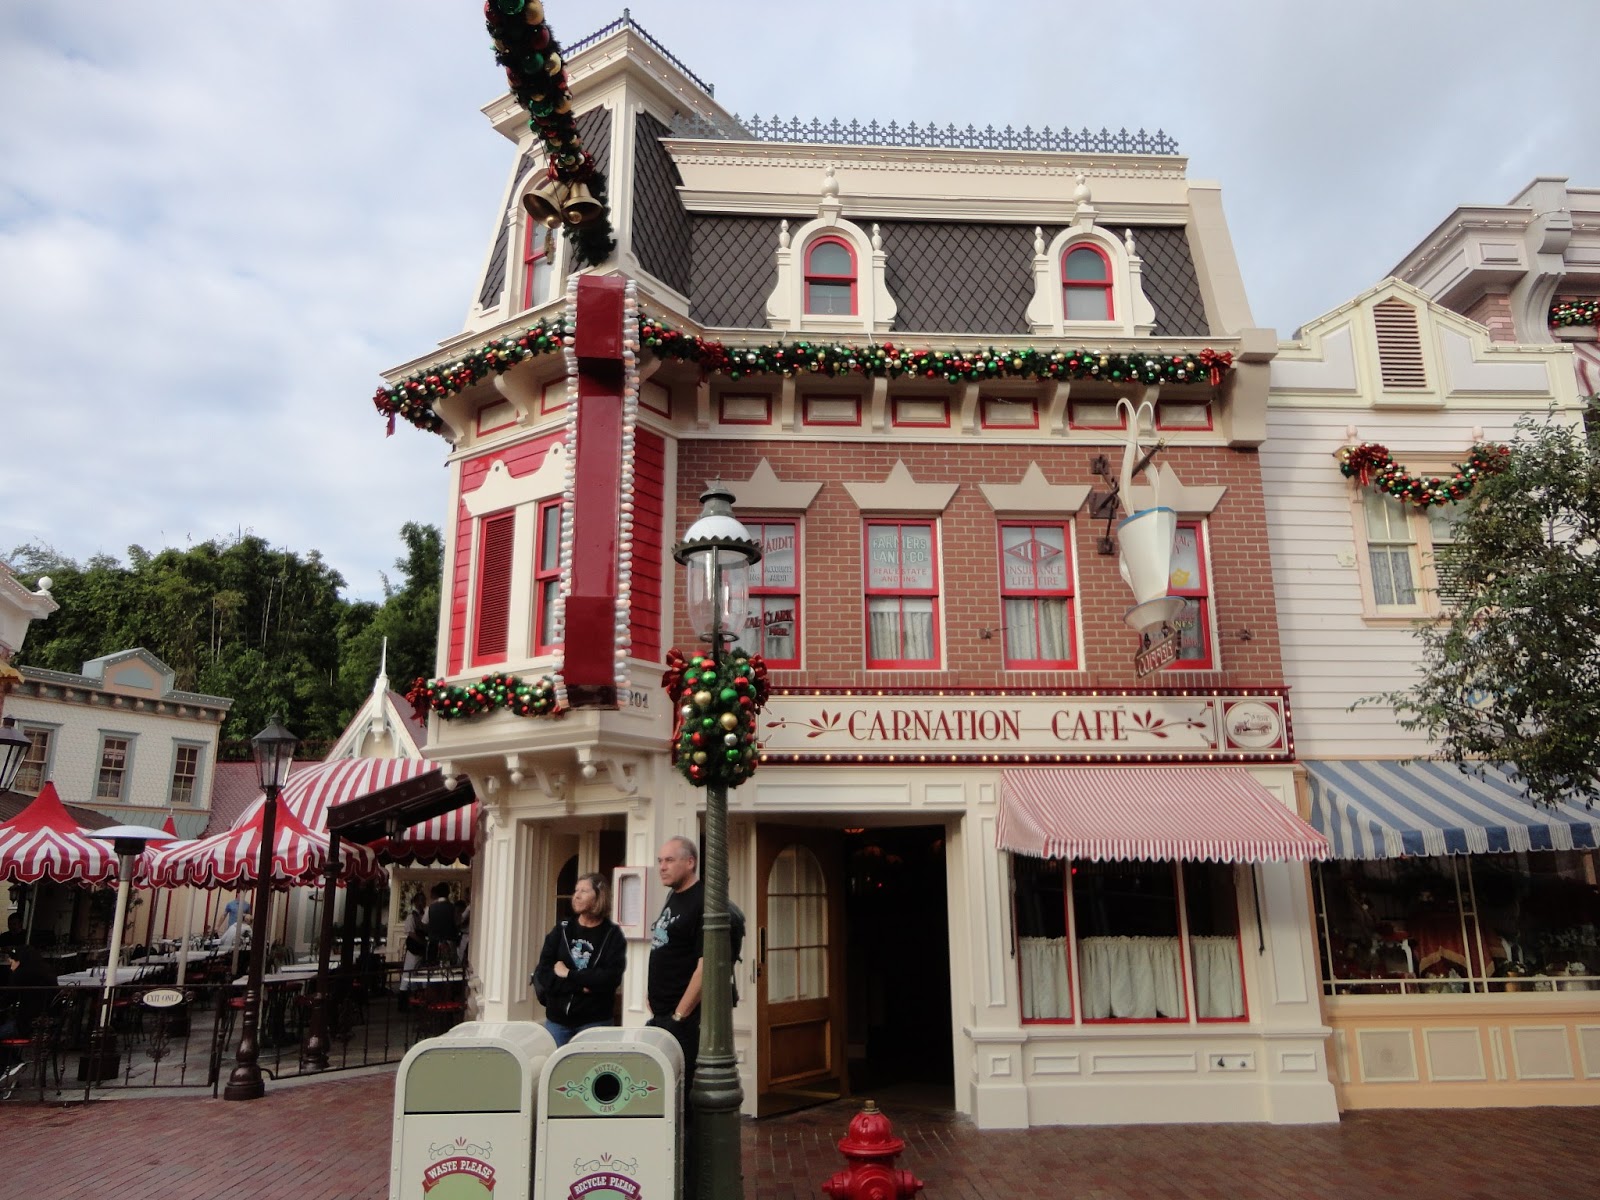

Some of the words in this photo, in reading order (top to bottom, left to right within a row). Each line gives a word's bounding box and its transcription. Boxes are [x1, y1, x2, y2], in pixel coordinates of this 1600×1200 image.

[765, 535, 795, 553] AUDIT
[872, 535, 927, 549] FARMERS
[1006, 565, 1064, 576] INSURANCE
[1011, 576, 1034, 586] LIFE
[1037, 576, 1061, 587] FIRE
[763, 610, 794, 626] CLARK
[848, 709, 1021, 741] CARNATION
[594, 1063, 622, 1075] BOTTLES
[599, 1104, 616, 1113] CANS
[427, 1160, 458, 1179] WASTE
[460, 1160, 493, 1179] PLEASE
[573, 1176, 607, 1195] RECYCLE
[609, 1176, 637, 1195] PLEASE
